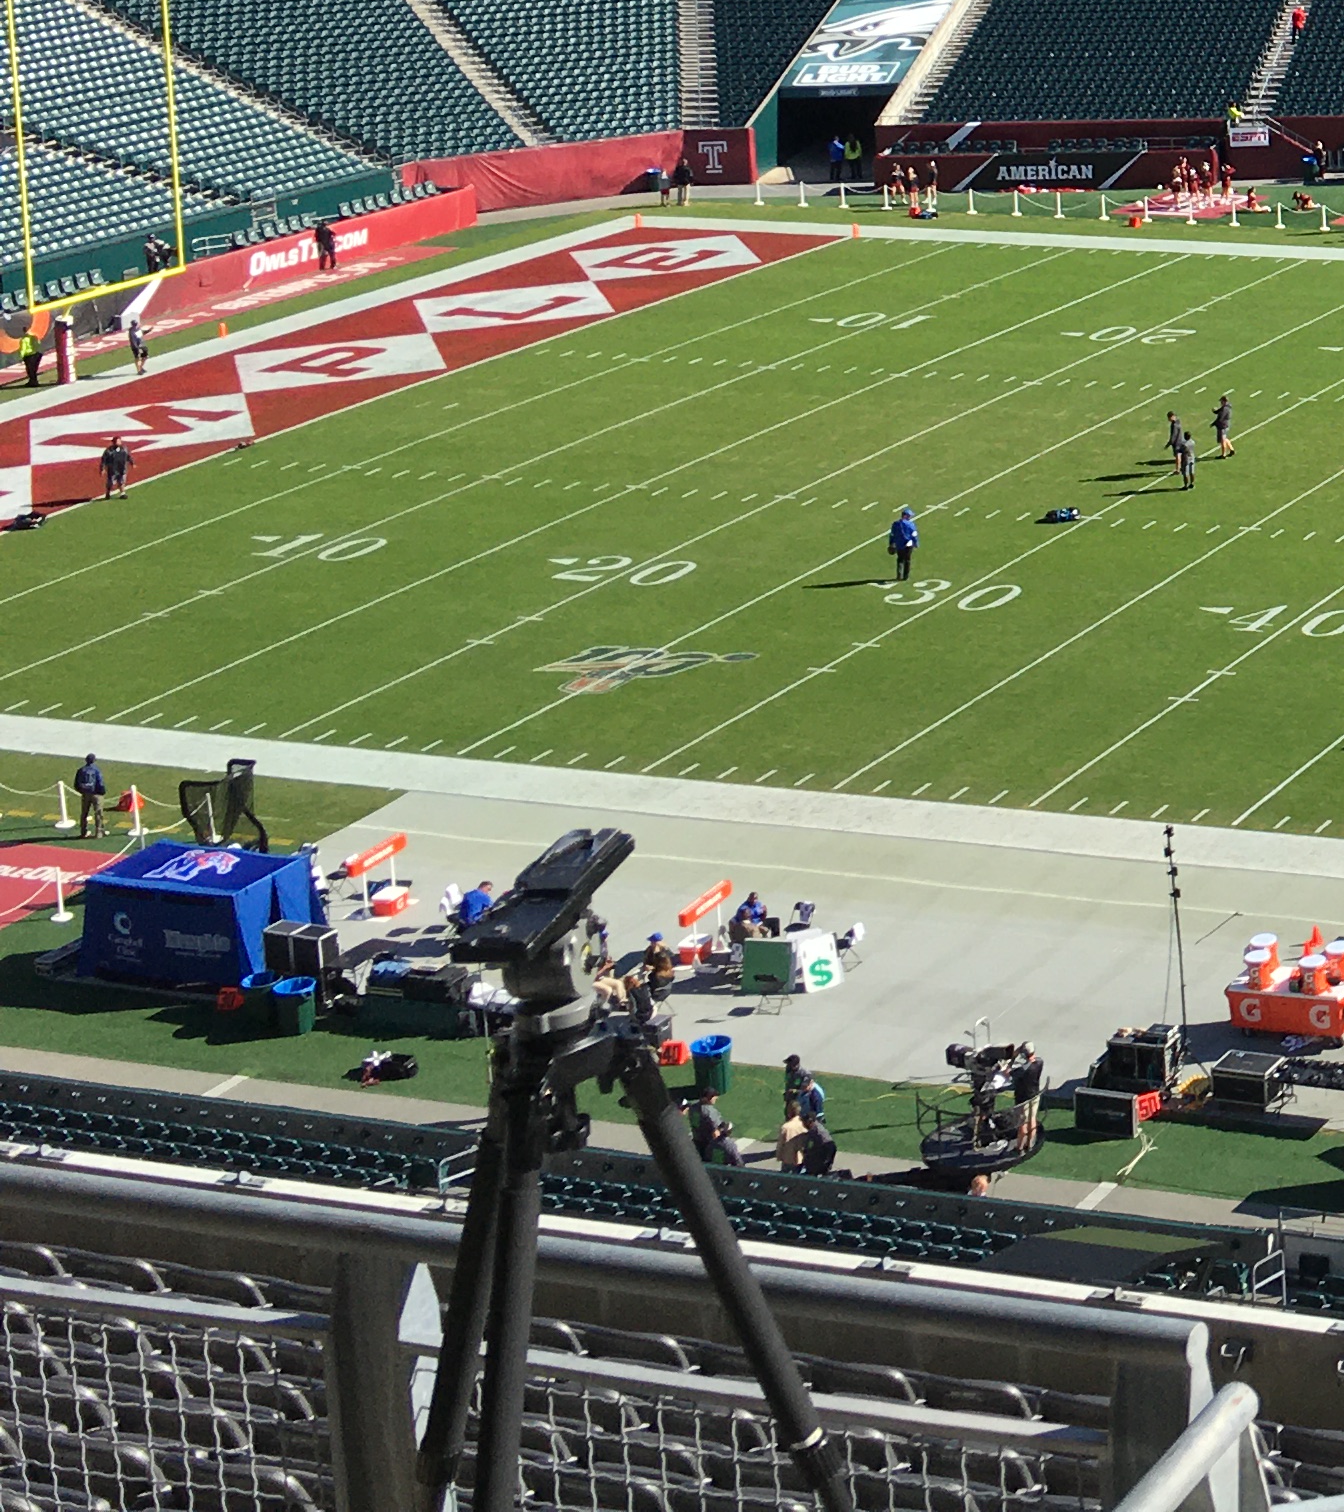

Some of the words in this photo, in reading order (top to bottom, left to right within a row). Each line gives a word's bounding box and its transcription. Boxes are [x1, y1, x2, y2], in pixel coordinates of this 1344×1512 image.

[801, 73, 888, 84] LIGHT
[818, 64, 881, 74] BUD
[1231, 132, 1267, 142] ESPN
[996, 159, 1094, 180] AMERICAN
[252, 533, 388, 563] 10
[553, 554, 697, 587] 20
[883, 578, 1023, 612] 30
[1239, 998, 1262, 1022] G
[1309, 1005, 1331, 1029] G
